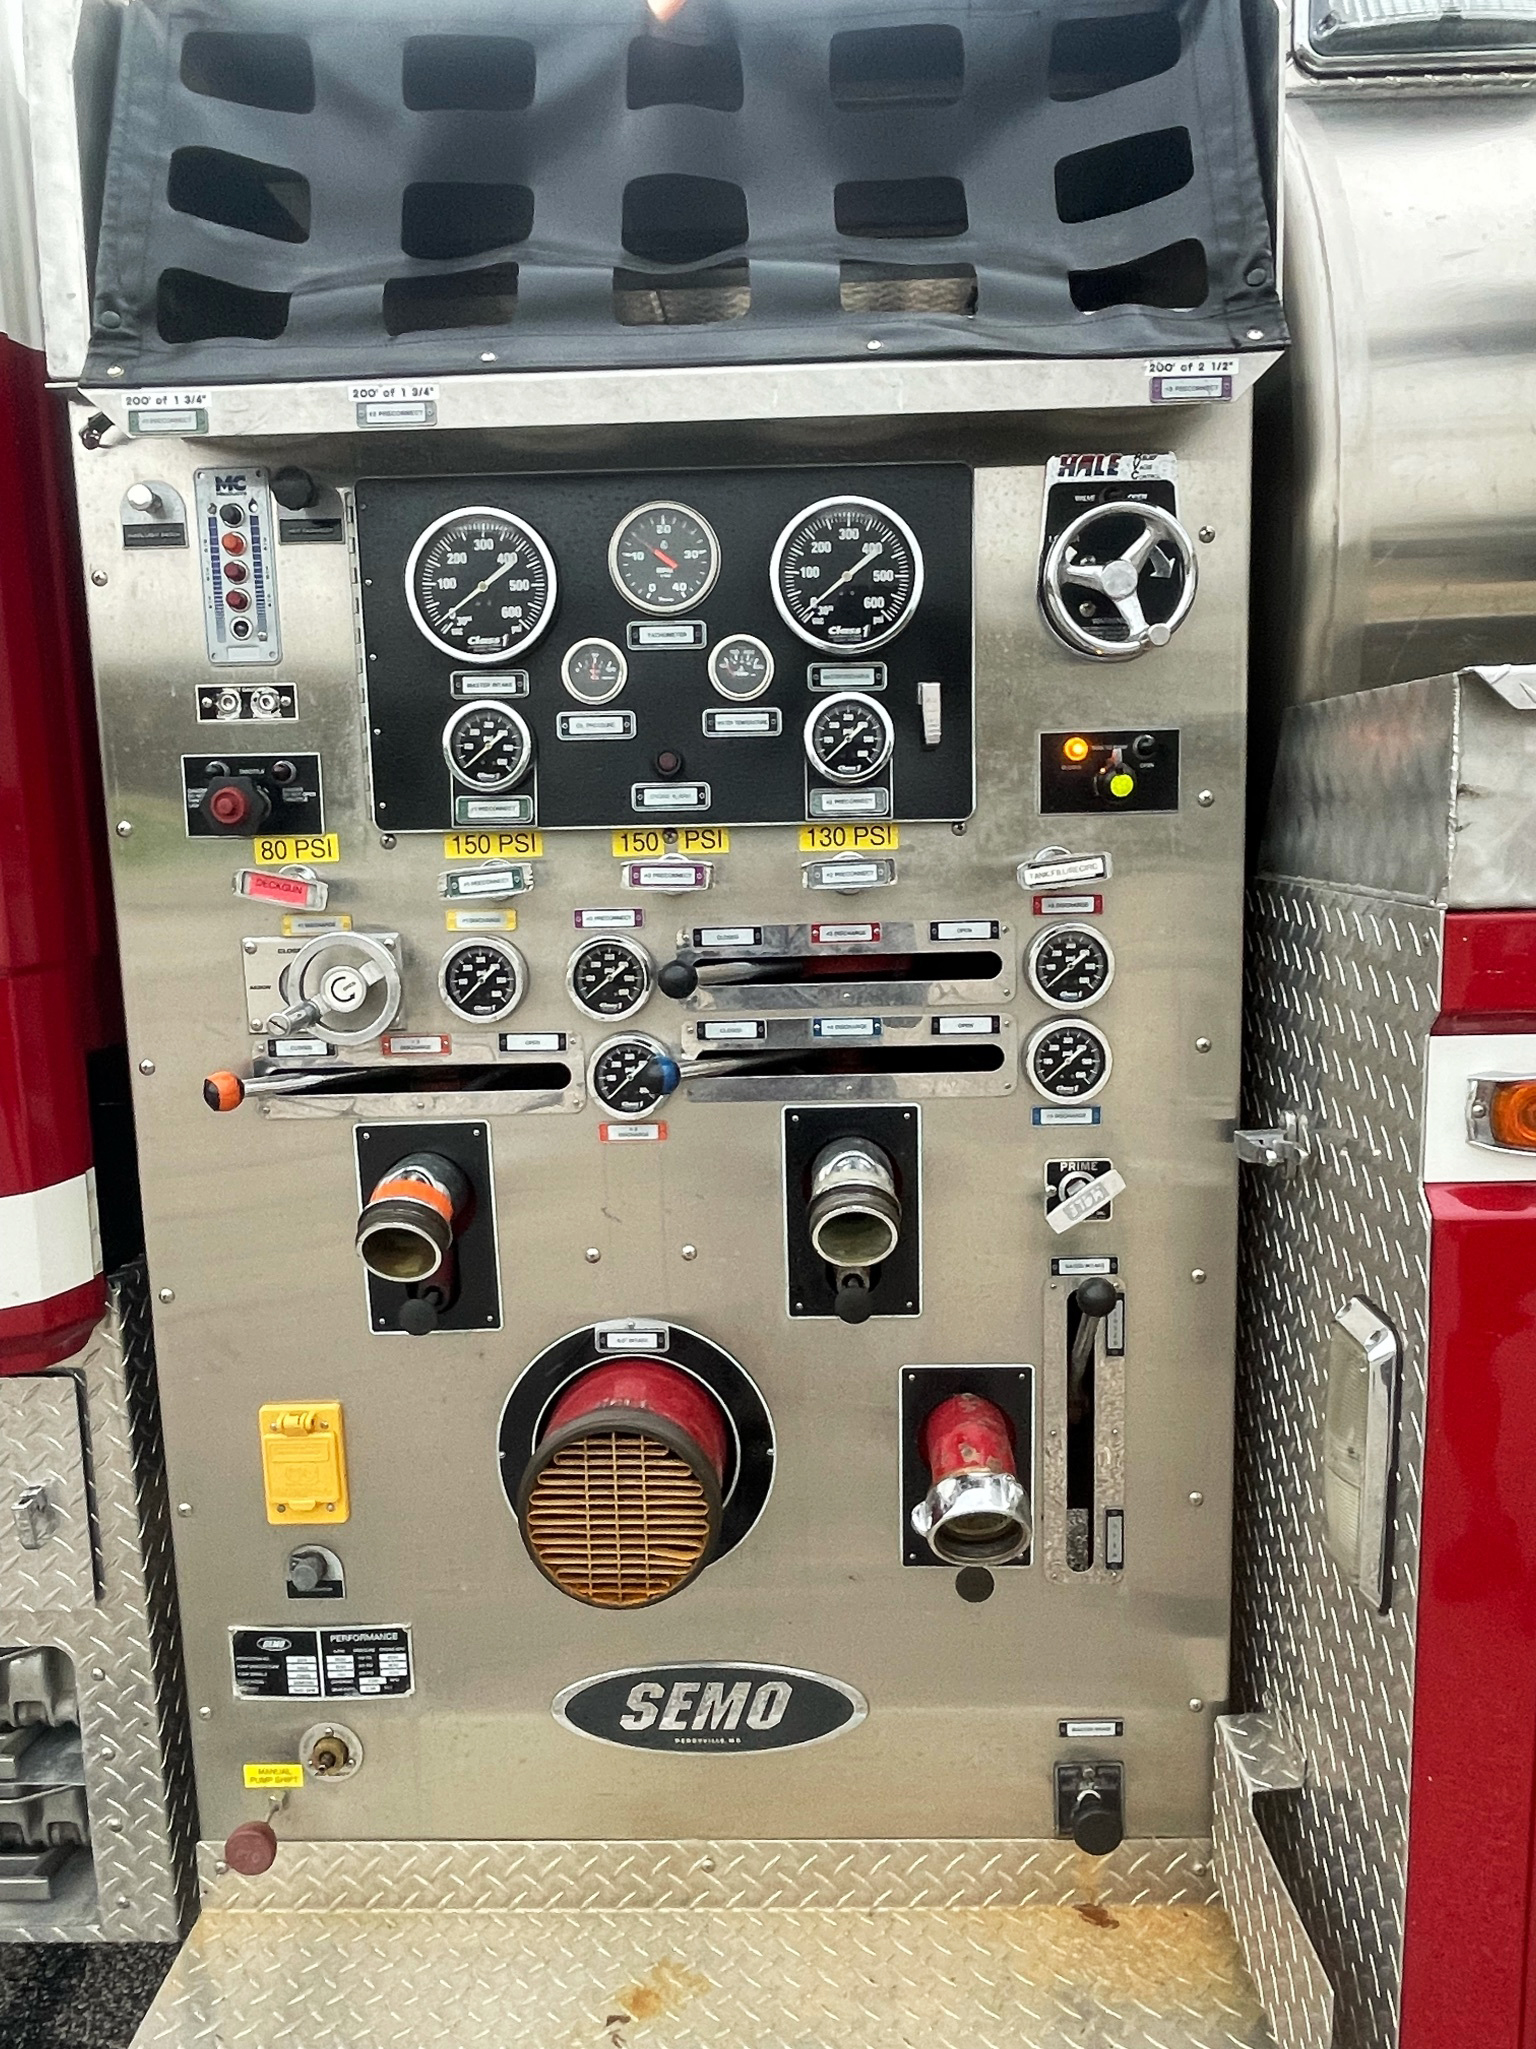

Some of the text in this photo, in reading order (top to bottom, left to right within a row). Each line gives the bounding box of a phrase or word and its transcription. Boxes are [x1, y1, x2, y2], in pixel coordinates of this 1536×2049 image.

[1180, 361, 1193, 372] of
[1199, 362, 1204, 371] 2
[383, 387, 395, 398] of
[401, 388, 406, 397] 1
[155, 395, 167, 405] of
[174, 395, 179, 404] 1
[1058, 453, 1122, 477] HALE
[215, 475, 247, 491] MC
[839, 528, 859, 540] 300
[473, 539, 494, 550] 300
[811, 541, 831, 553] 200
[447, 552, 467, 564] 200
[632, 551, 645, 561] 10
[684, 550, 699, 559] 30
[800, 566, 820, 578] 100
[873, 570, 894, 582] 500
[437, 577, 457, 590] 100
[509, 580, 529, 591] 500
[648, 583, 656, 592] 0
[672, 582, 687, 592] 40
[864, 597, 884, 608] 600
[502, 606, 522, 618] 600
[620, 829, 722, 852] 150 PSI
[807, 826, 892, 847] 130 PSI
[261, 838, 333, 860] 80 PSI
[452, 833, 536, 854] 150 PSI
[1060, 1162, 1098, 1172] PRIME
[330, 1632, 399, 1643] PERFORMANCE
[619, 1681, 793, 1731] SEMO
[275, 1775, 298, 1783] SHIFT
